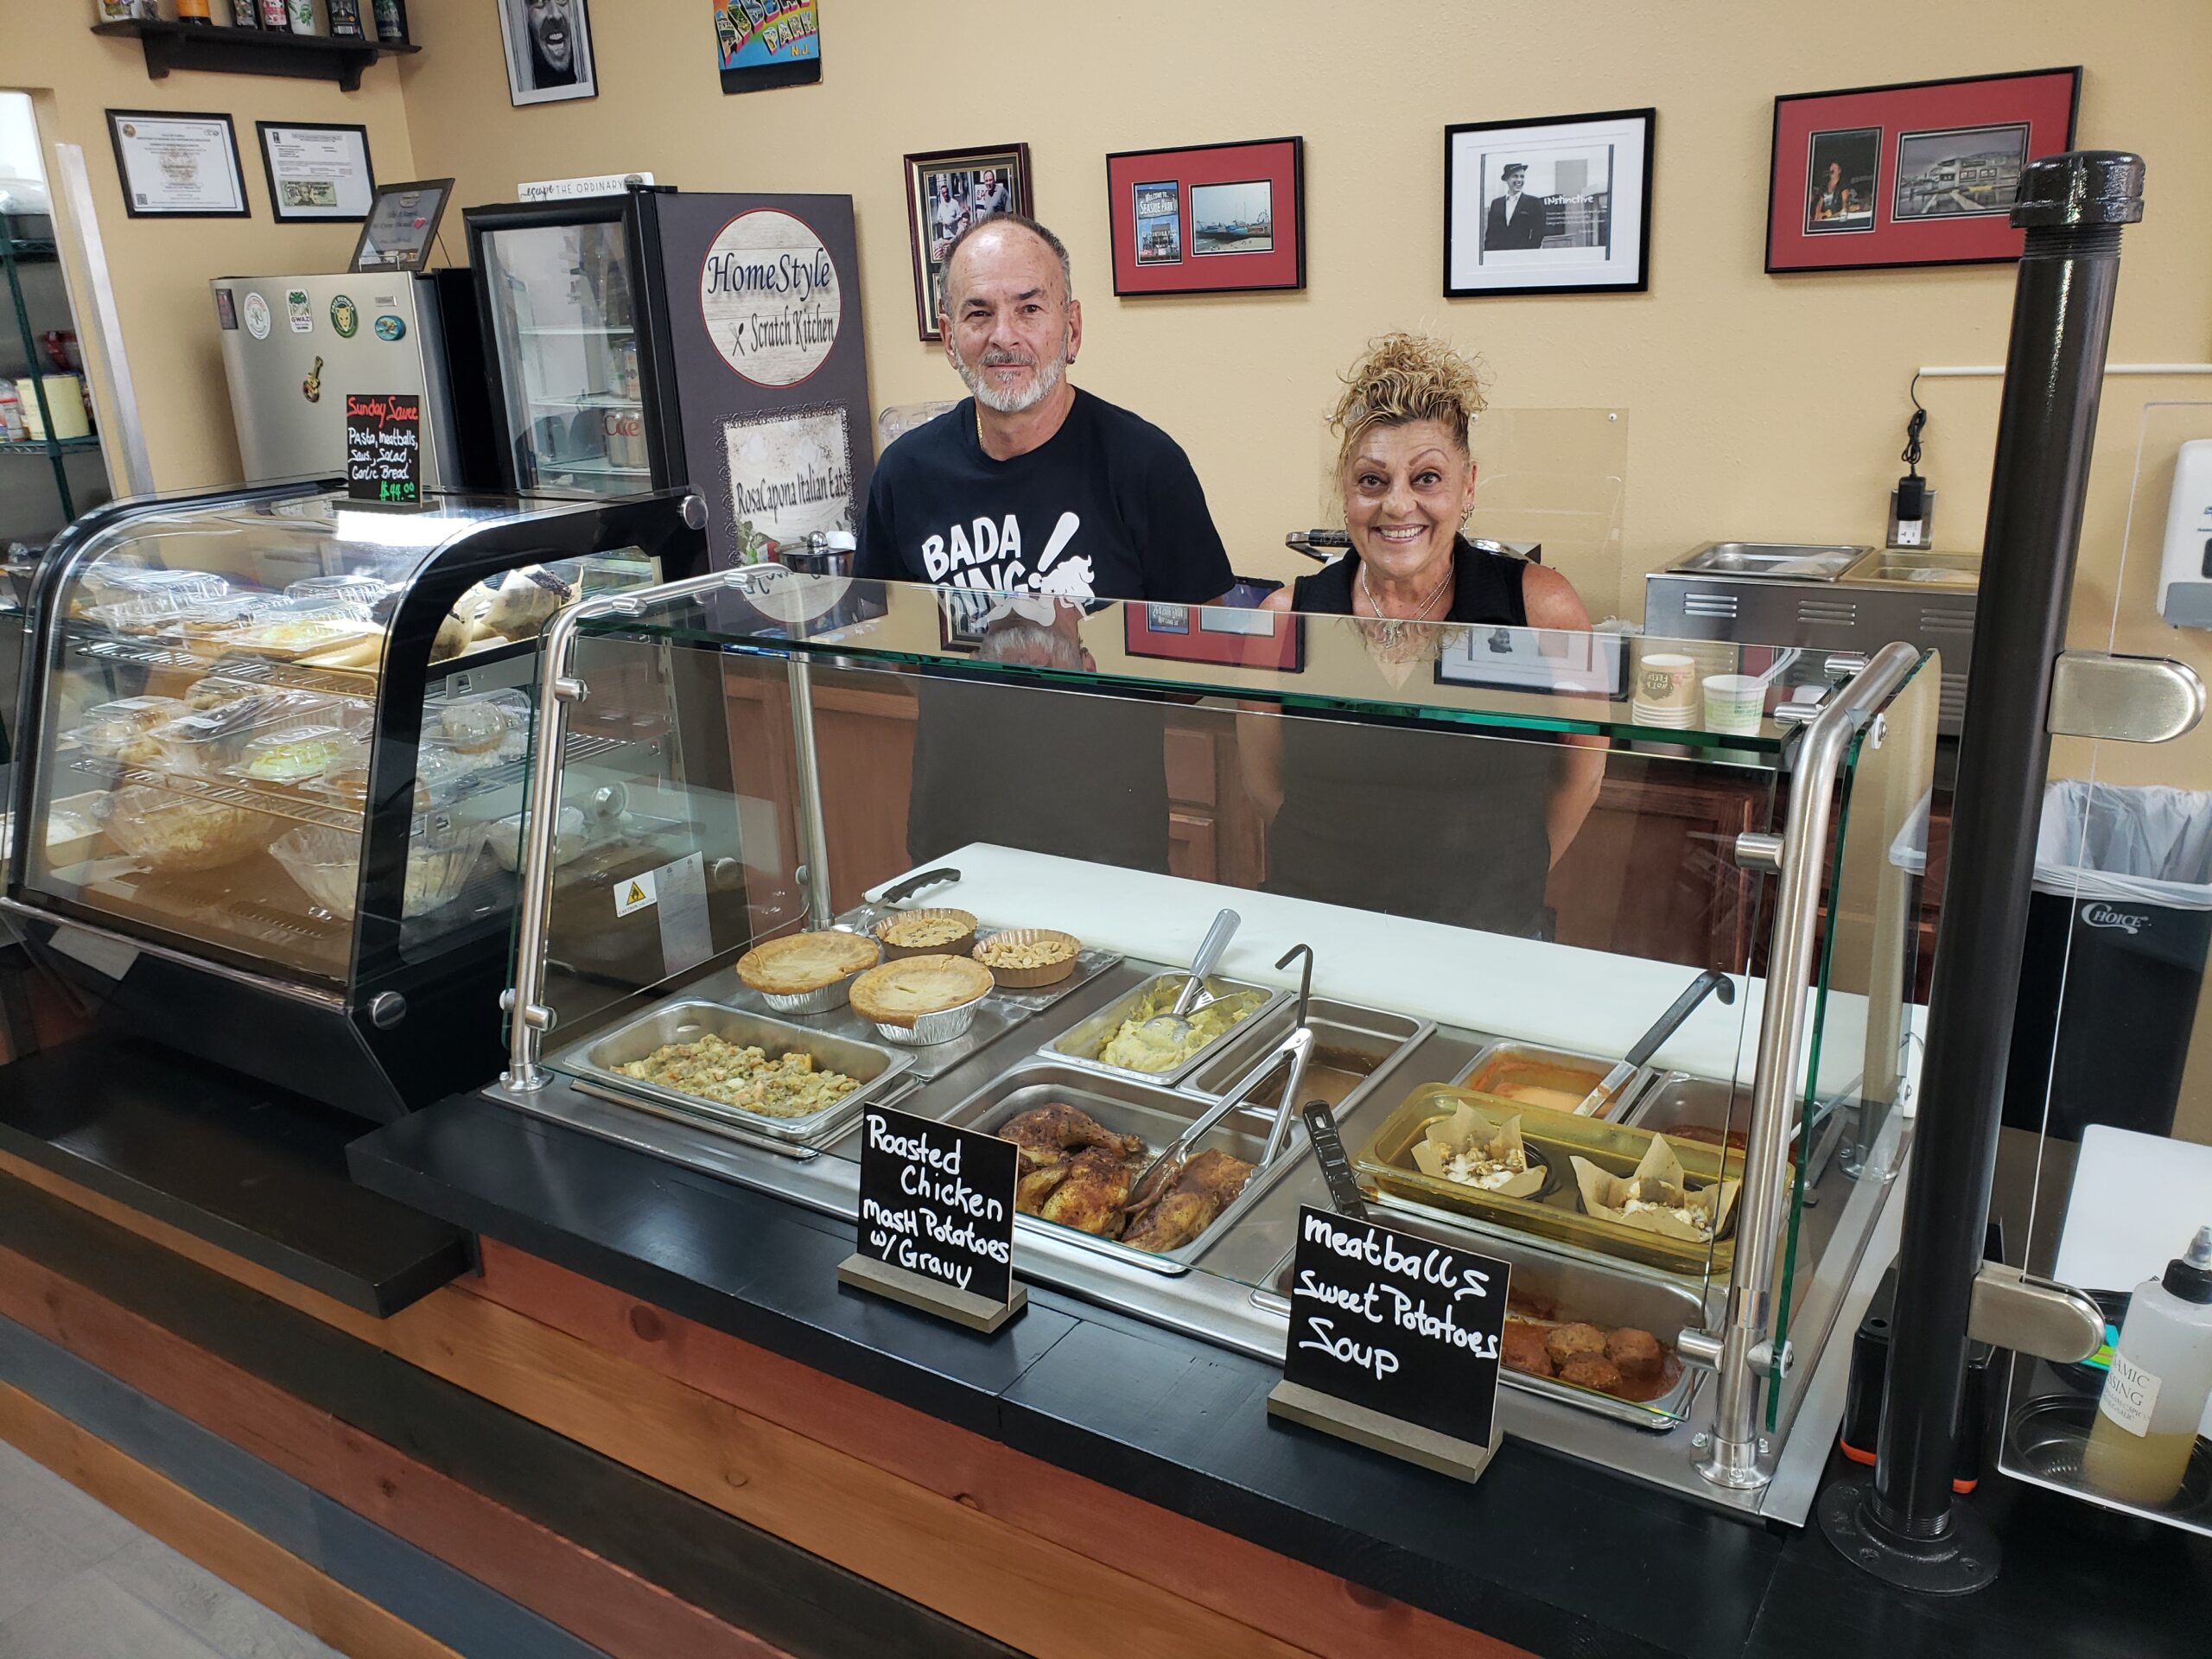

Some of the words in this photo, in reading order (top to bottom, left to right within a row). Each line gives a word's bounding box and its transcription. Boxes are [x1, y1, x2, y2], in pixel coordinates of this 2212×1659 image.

[715, 0, 811, 67] ASBU
[763, 11, 817, 55] PARK
[520, 184, 554, 201] escape
[556, 185, 572, 194] THE
[576, 179, 625, 194] ORDINARY
[707, 247, 830, 302] HomeStyle
[751, 304, 791, 353] Scratch
[792, 302, 835, 353] Kitchen
[346, 397, 386, 429] Sunday
[352, 466, 378, 480] Garlic
[736, 478, 797, 524] RosaCapona
[797, 462, 829, 505] Italian
[828, 467, 849, 499] Eats
[921, 514, 1021, 582] BADA
[2082, 902, 2149, 934] CHOICE
[867, 1114, 961, 1175] Roasted
[900, 1165, 1002, 1222] Chicken
[870, 1230, 897, 1260] w/
[899, 1238, 972, 1290] Gravy
[919, 1208, 1009, 1263] Potatoes
[1299, 1317, 1399, 1380] Soup
[1380, 1283, 1498, 1359] Potatoes
